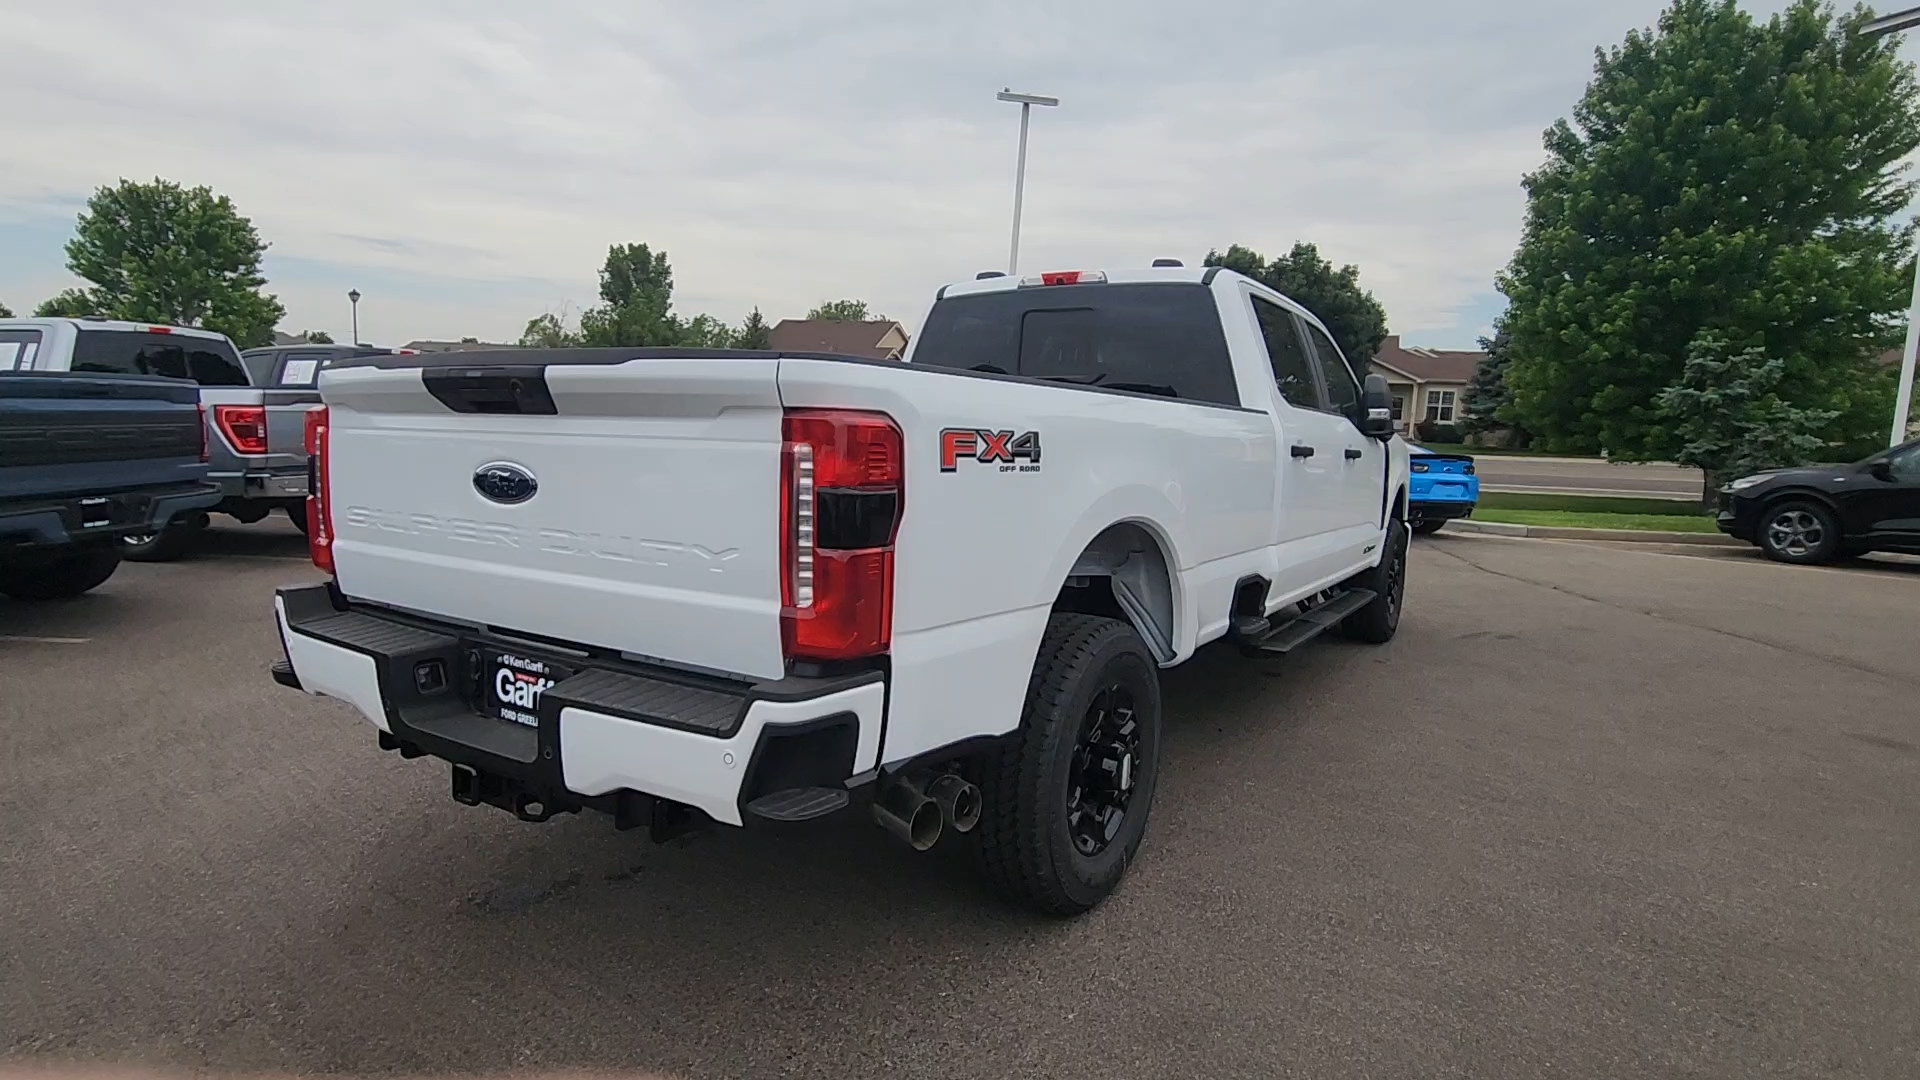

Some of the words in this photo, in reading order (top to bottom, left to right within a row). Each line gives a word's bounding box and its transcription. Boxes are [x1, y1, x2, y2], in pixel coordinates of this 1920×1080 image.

[940, 427, 1041, 472] FX4
[999, 465, 1016, 473] OFF
[1019, 465, 1041, 473] ROAD
[346, 505, 520, 548] SUPER
[539, 527, 740, 573] DUTY
[509, 655, 524, 669] Ken
[524, 658, 543, 673] Garff
[501, 707, 516, 721] FORD
